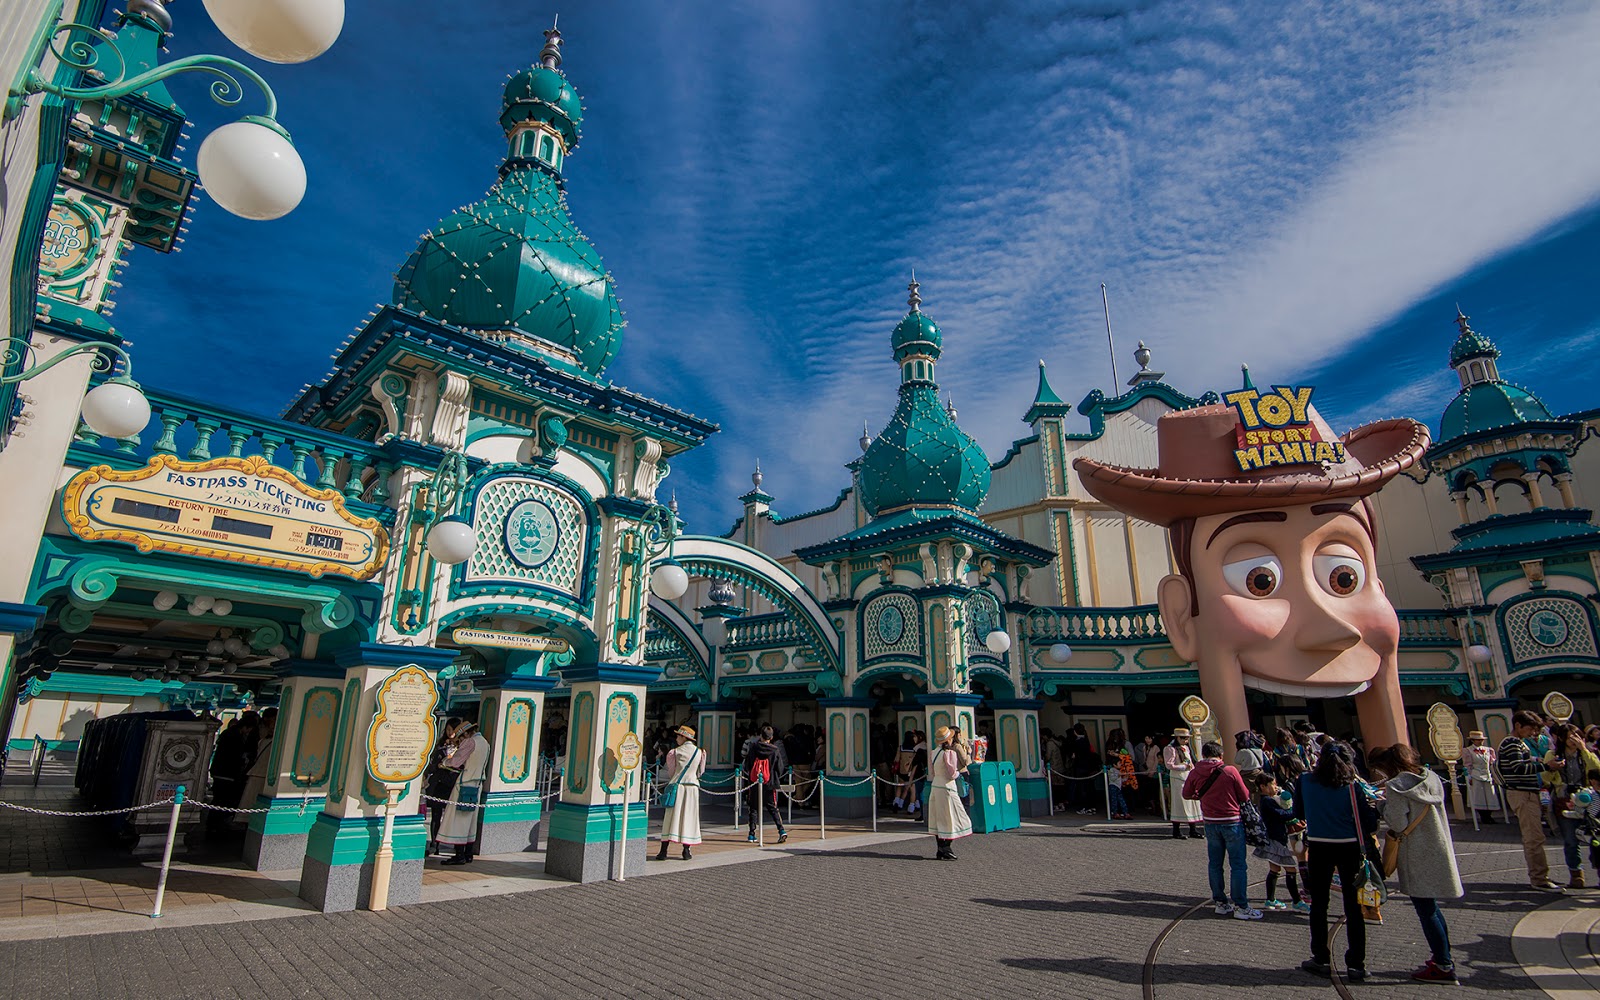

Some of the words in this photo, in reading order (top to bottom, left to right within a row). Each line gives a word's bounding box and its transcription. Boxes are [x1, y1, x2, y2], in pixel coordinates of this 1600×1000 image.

[1222, 386, 1315, 429] TOY
[1245, 428, 1313, 445] STORY
[1234, 442, 1346, 471] MANIA!
[166, 472, 248, 489] FASTPASS
[254, 479, 326, 513] TICKETING
[168, 499, 204, 512] RETURN
[208, 506, 229, 516] TIME
[309, 525, 343, 536] STANDBY
[460, 631, 495, 639] FASTPASS
[497, 634, 531, 643] TICKETING
[532, 638, 563, 646] ENTRANCE
